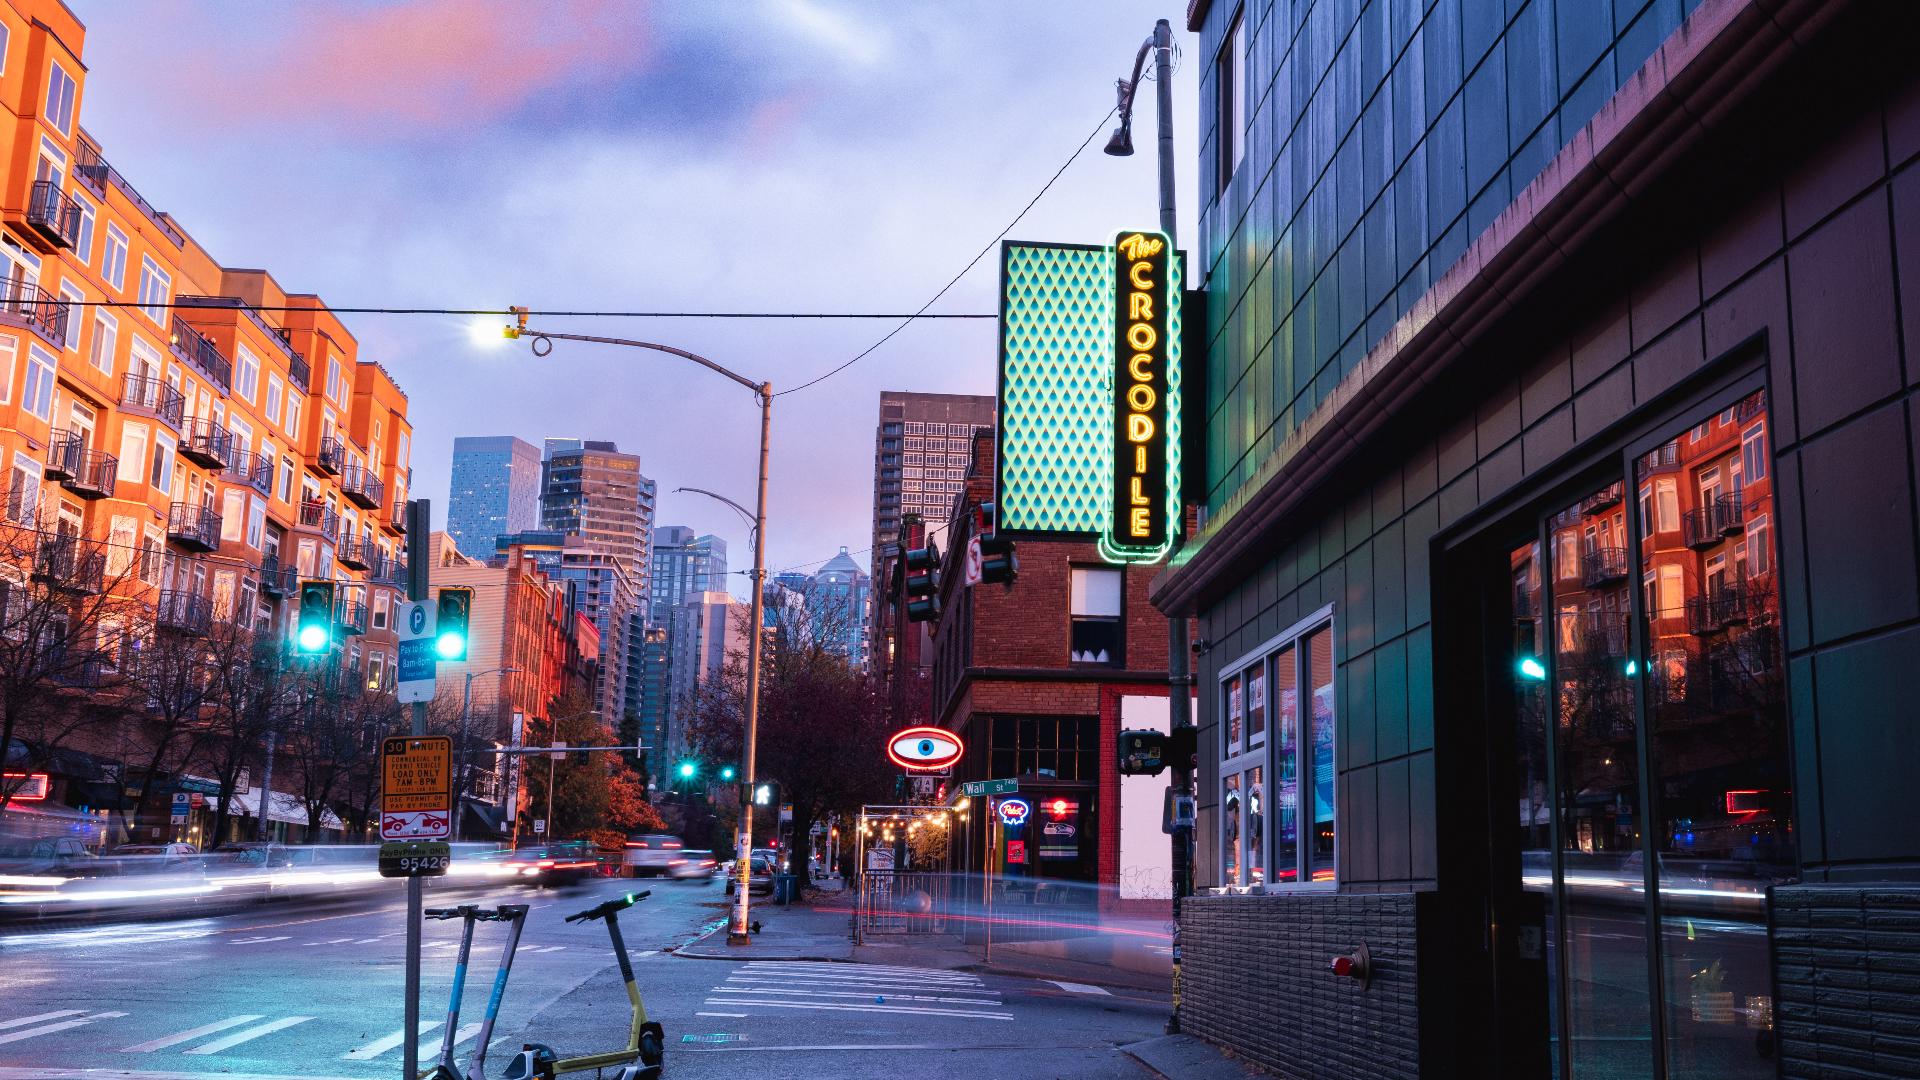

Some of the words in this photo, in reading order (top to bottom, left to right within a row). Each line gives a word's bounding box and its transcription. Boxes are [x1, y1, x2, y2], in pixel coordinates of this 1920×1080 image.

[1119, 233, 1163, 261] The
[1126, 261, 1158, 538] CROCODILE
[400, 645, 411, 657] Pay
[412, 643, 419, 653] to
[419, 643, 435, 652] Pk
[402, 658, 431, 668] 8am-8pm
[387, 742, 403, 752] 30
[392, 770, 414, 779] LOAD
[417, 769, 440, 778] ONLY
[966, 783, 985, 794] Wall
[996, 784, 1004, 792] St
[1003, 804, 1025, 816] Pabst
[380, 848, 426, 858] PayByPhone
[430, 847, 450, 855] ONLY
[400, 856, 449, 870] 95426
